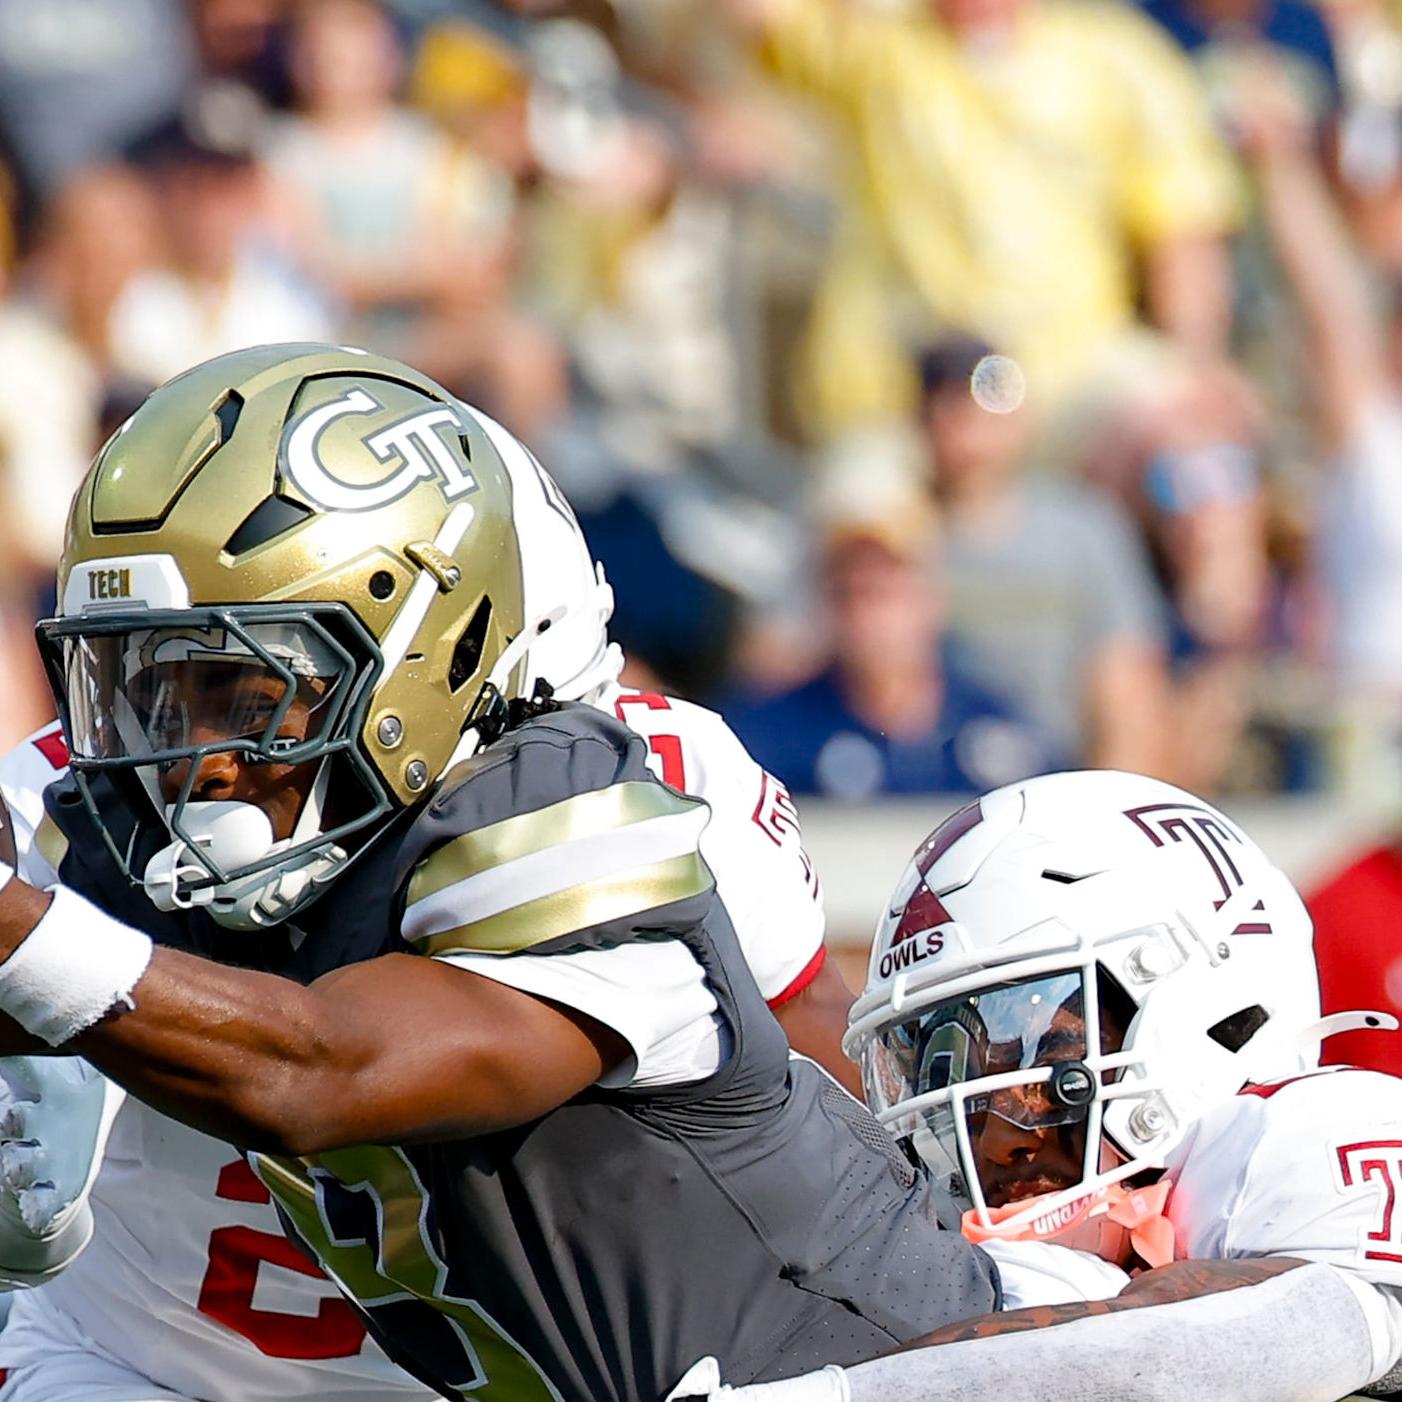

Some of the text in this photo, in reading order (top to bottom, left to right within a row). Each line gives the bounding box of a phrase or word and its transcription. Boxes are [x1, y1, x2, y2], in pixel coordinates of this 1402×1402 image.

[278, 384, 480, 514] GT
[87, 568, 131, 600] TECH
[1122, 803, 1273, 936] T
[879, 930, 944, 979] OWLS
